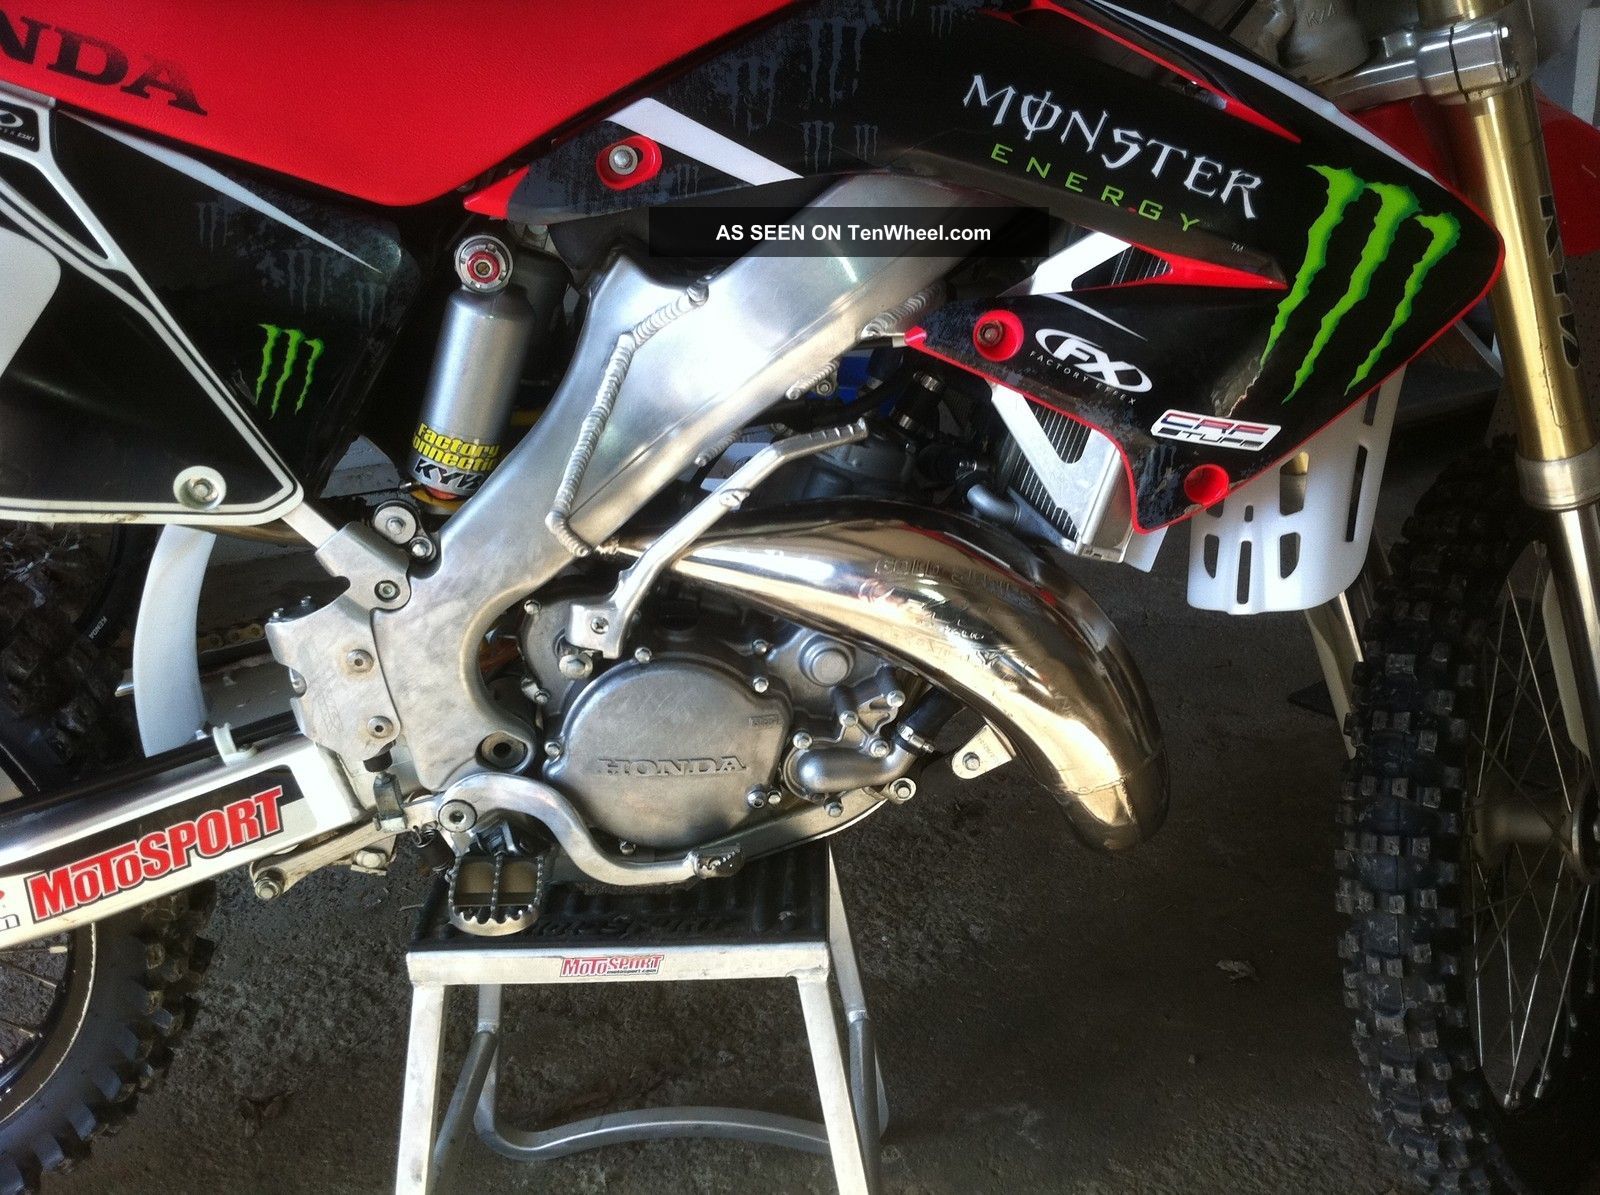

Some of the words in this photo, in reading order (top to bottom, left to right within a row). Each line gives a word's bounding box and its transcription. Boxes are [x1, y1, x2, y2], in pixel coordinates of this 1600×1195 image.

[962, 74, 1262, 220] MONSTER
[990, 143, 1200, 231] ENERGY
[1030, 351, 1089, 383] FACTORY
[417, 422, 500, 458] Factory
[599, 755, 748, 777] HONDA
